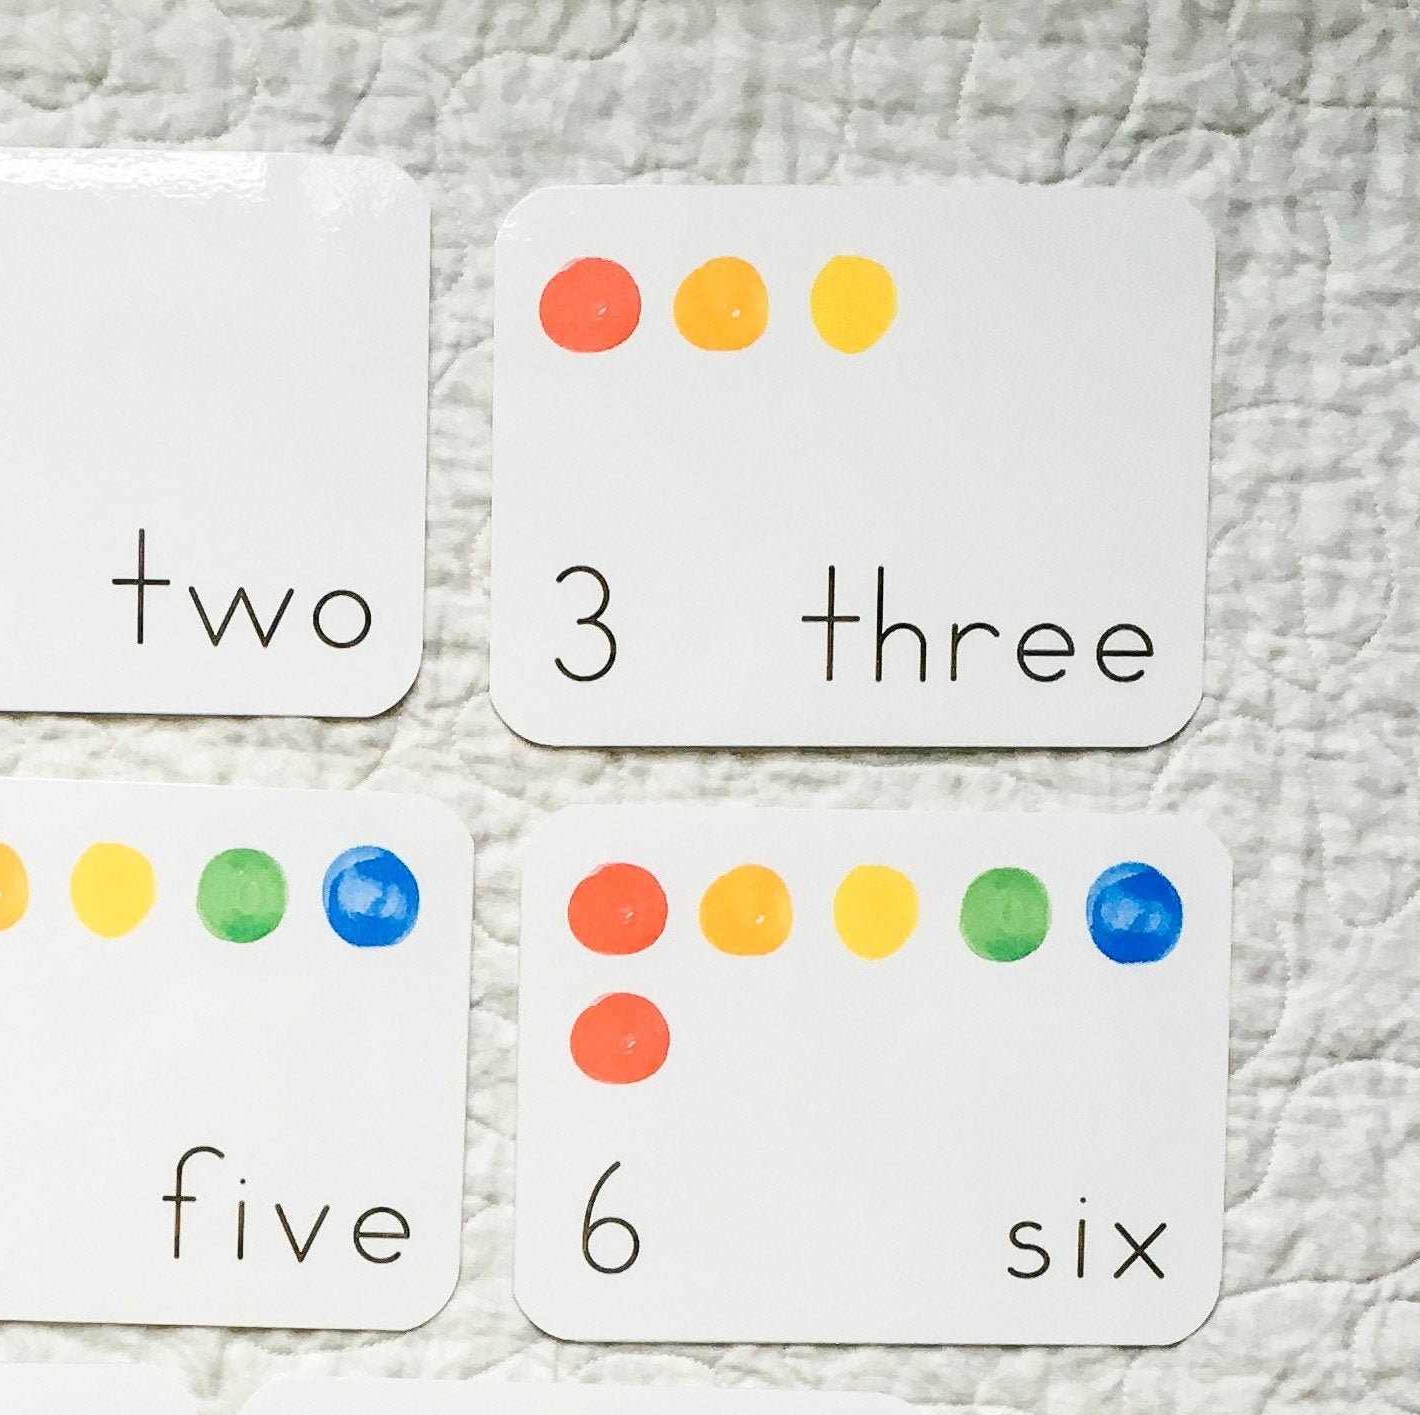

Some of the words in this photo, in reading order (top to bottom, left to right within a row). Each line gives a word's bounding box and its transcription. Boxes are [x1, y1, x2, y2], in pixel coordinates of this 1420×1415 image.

[111, 527, 372, 650] two
[554, 564, 617, 683] 3
[800, 564, 1155, 684] three
[161, 1145, 411, 1265] five
[581, 1160, 641, 1275] 6
[1007, 1196, 1168, 1280] six
